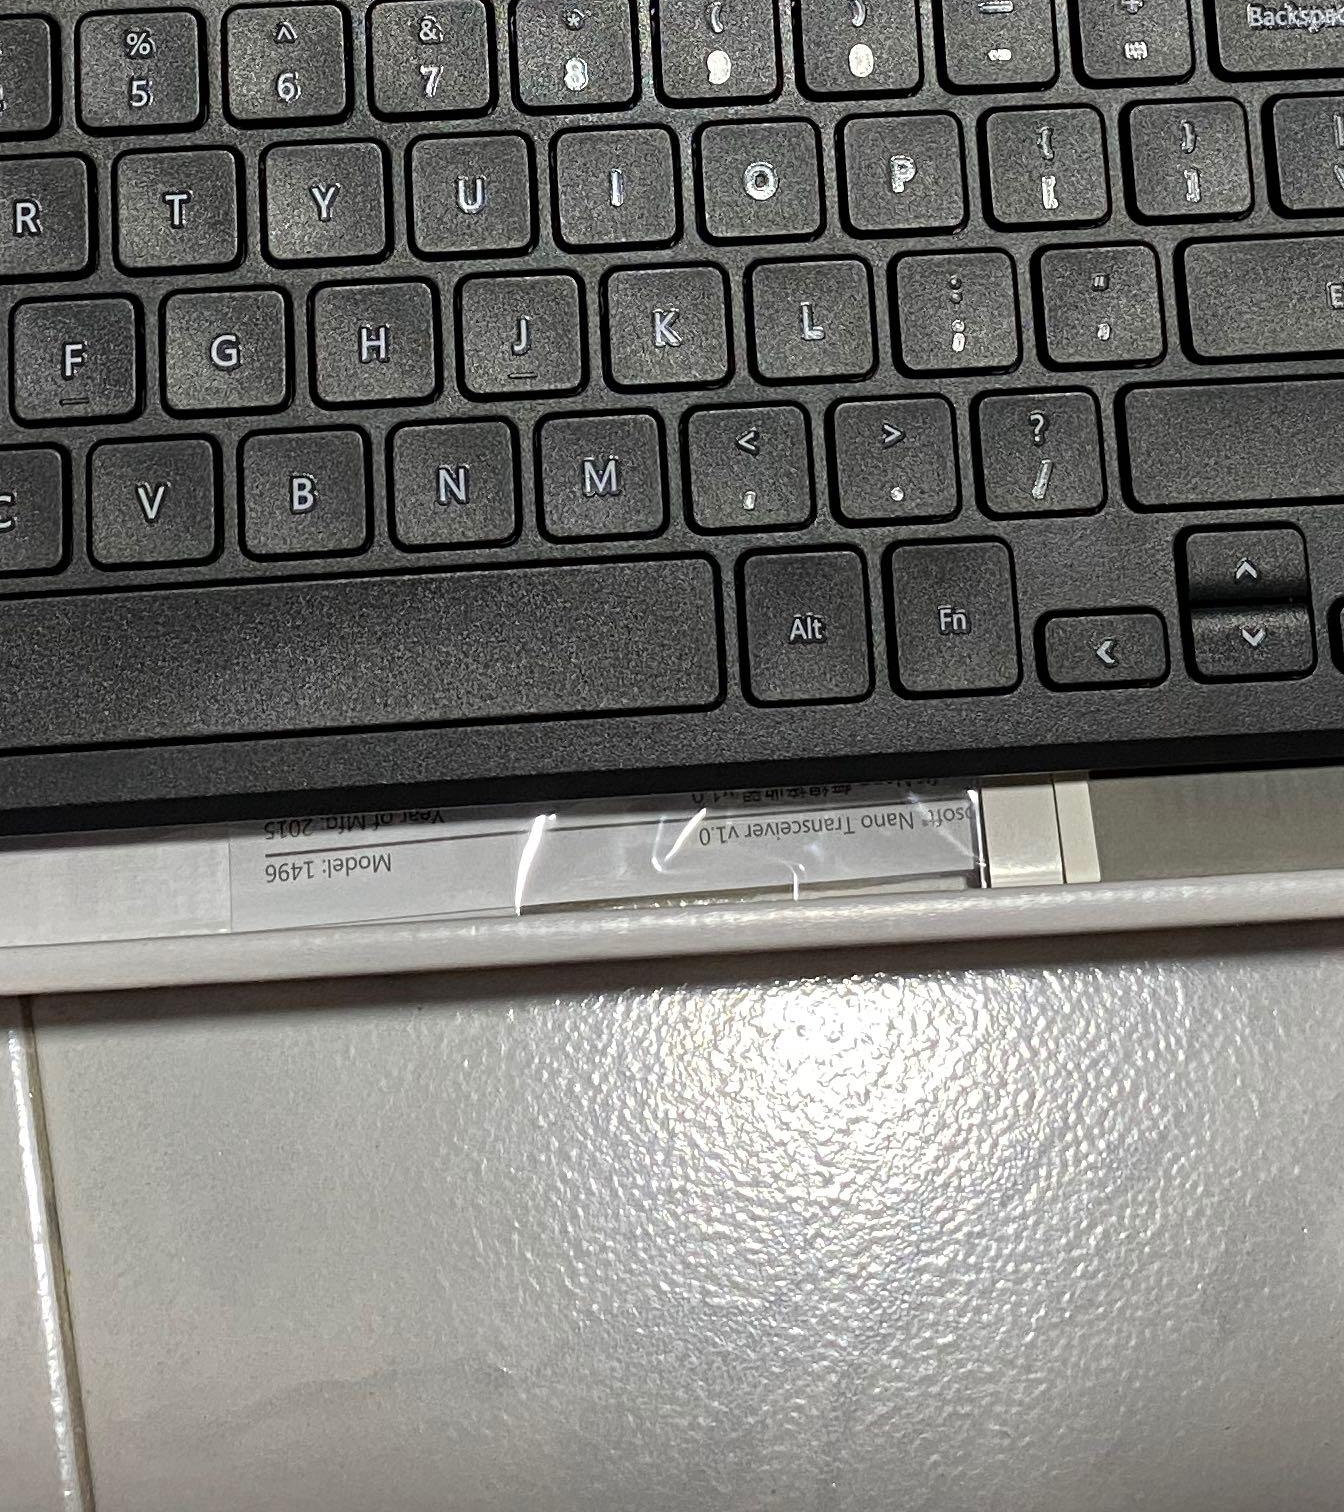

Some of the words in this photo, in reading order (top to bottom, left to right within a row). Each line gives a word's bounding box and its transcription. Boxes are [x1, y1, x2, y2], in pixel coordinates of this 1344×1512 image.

[126, 33, 151, 55] %
[276, 72, 299, 99] 6
[420, 65, 443, 96] 7
[564, 57, 587, 90] 8
[131, 80, 152, 106] 5
[744, 162, 778, 201] O
[891, 156, 916, 193] P
[166, 191, 189, 227] T
[311, 185, 339, 220] Y
[458, 176, 486, 214] U
[15, 201, 40, 233] R
[512, 317, 531, 355] J
[654, 309, 681, 346] K
[801, 302, 824, 340] L
[210, 335, 239, 367] G
[360, 323, 389, 362] H
[64, 343, 84, 377] F
[438, 466, 468, 504] N
[584, 456, 618, 496] M
[138, 485, 166, 520] V
[291, 476, 316, 511] B
[790, 614, 824, 641] Alt
[938, 605, 967, 633] Fn
[264, 818, 313, 840] 2015
[698, 824, 739, 846] v1.0
[744, 814, 855, 841] Transceiver
[861, 810, 914, 831] Nano
[265, 860, 315, 883] 1496
[322, 853, 392, 879] Model:
